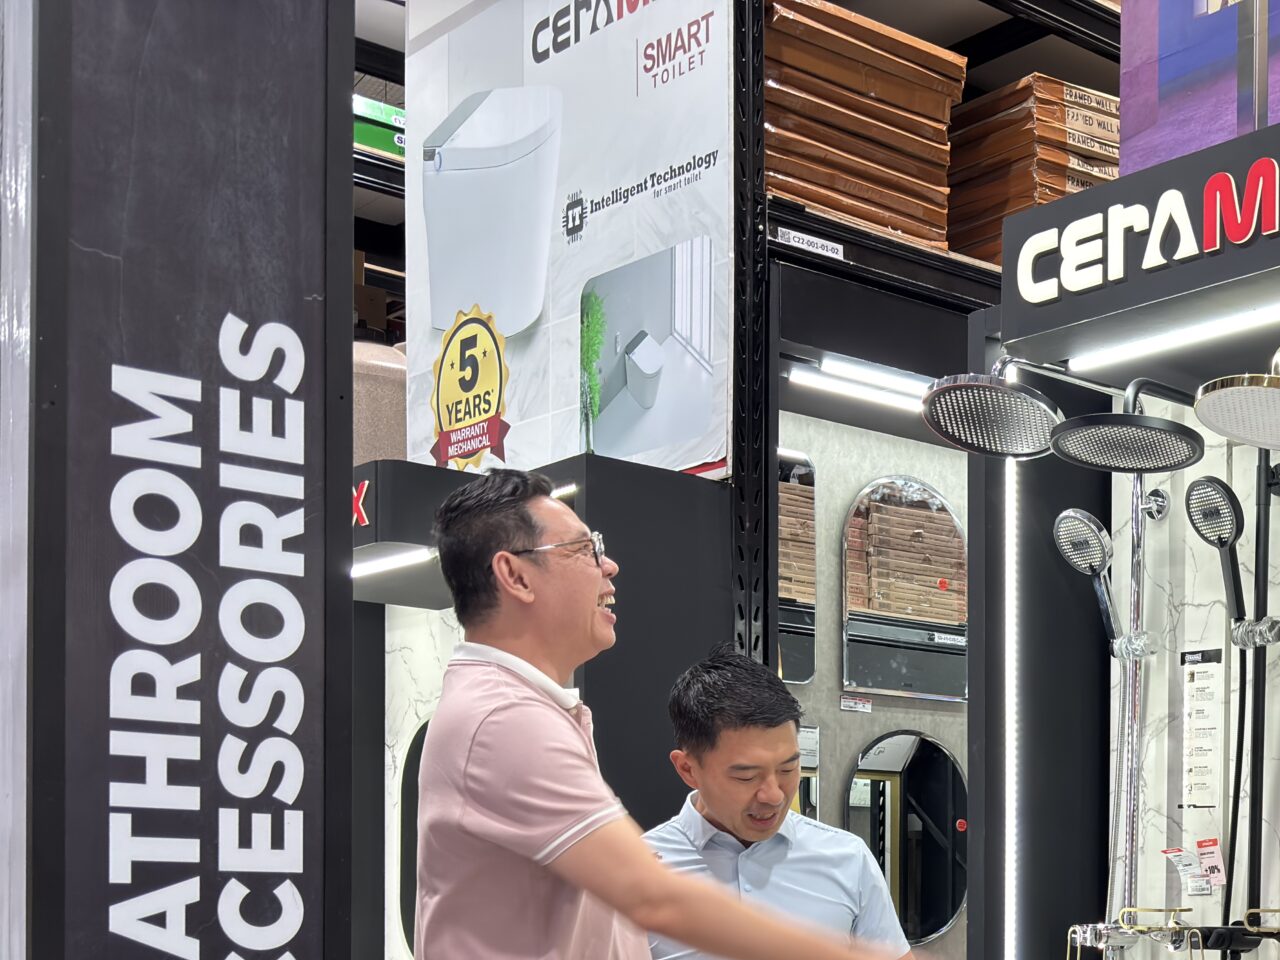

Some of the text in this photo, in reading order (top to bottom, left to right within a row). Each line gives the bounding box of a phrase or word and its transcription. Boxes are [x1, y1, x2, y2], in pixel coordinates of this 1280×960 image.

[643, 10, 714, 73] SMART
[652, 50, 705, 89] TOILET
[1095, 97, 1114, 112] WALL
[1096, 119, 1114, 134] WALL
[589, 149, 719, 214] Intelligent Technology
[653, 171, 702, 199] for smart toilet
[792, 235, 840, 256] C22-001-01-02
[457, 334, 479, 394] 5
[448, 433, 492, 458] MECHANICAL
[450, 421, 489, 444] WARRANTY
